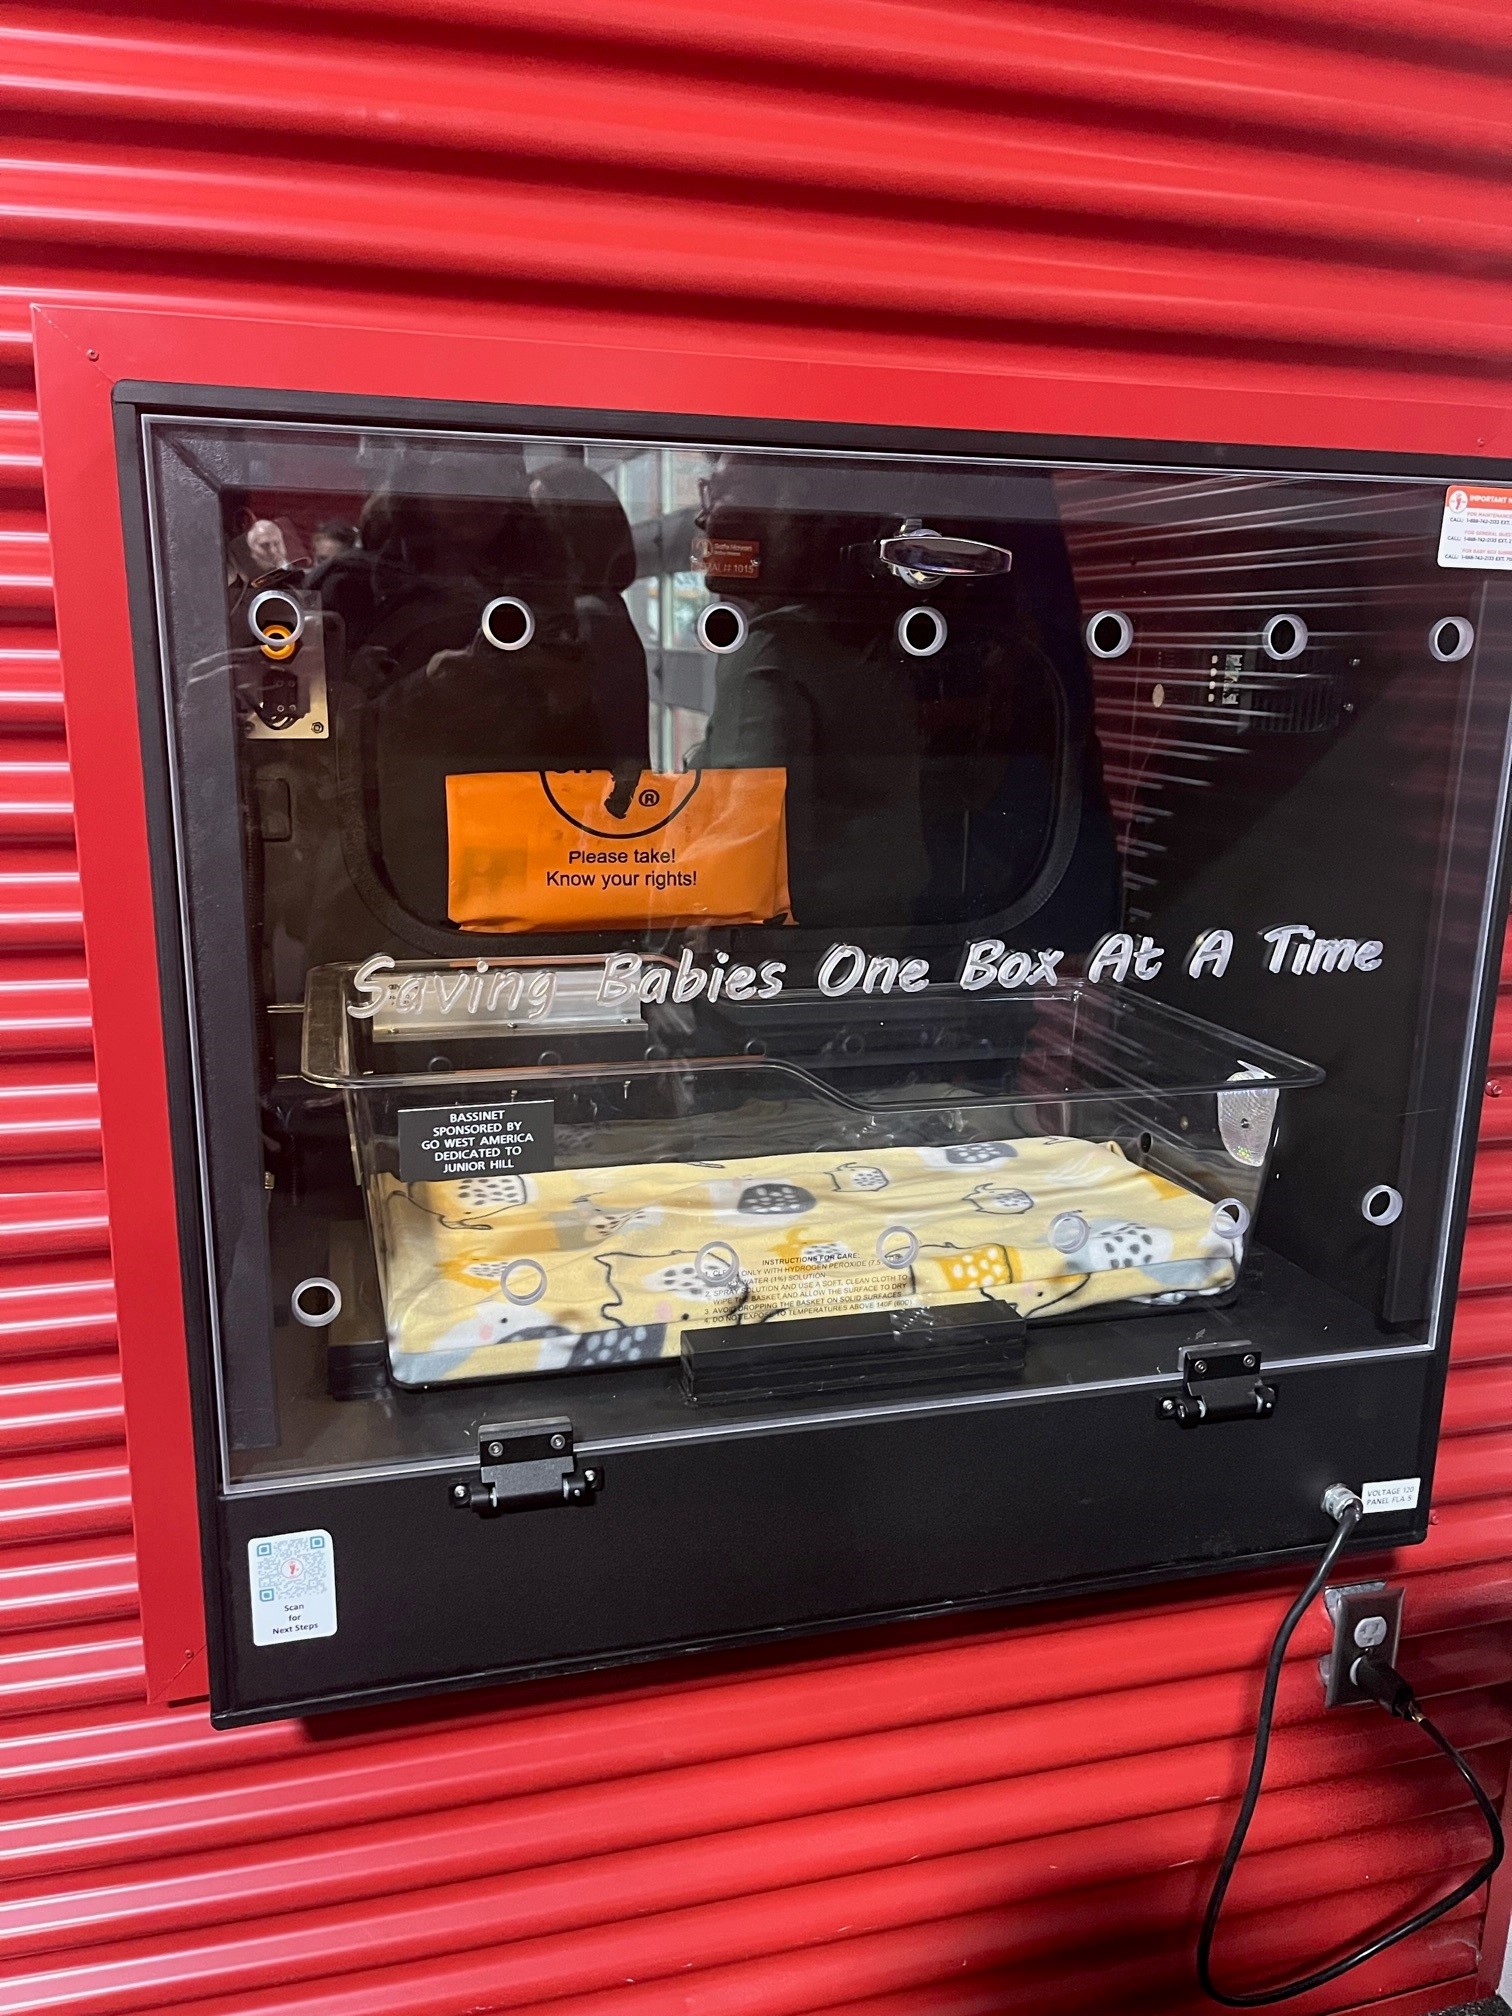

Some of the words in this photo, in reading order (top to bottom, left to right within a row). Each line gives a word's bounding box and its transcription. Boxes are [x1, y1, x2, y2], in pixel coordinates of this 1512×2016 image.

[1470, 494, 1508, 504] IMPORTANT
[568, 850, 628, 864] Please
[634, 848, 676, 863] take!
[546, 871, 596, 886] Know
[601, 874, 640, 890] your
[645, 870, 698, 889] rights!
[347, 954, 559, 1023] Saving
[597, 948, 788, 1007] Babies
[815, 941, 930, 997] One
[961, 938, 1065, 991] Box
[1086, 932, 1164, 984] At
[1188, 928, 1234, 979] A
[1261, 923, 1383, 976] Time
[450, 1110, 506, 1123] BASSINET
[432, 1124, 502, 1137] SPONSORED
[506, 1121, 522, 1130] BY
[421, 1140, 440, 1150] GO
[444, 1136, 476, 1148] WEST
[479, 1132, 534, 1146] AMERICA
[434, 1148, 500, 1162] DEDICATED
[505, 1146, 522, 1156] TO
[442, 1160, 486, 1174] JUNIOR
[490, 1158, 514, 1170] HILL
[741, 1268, 761, 1276] ONLY
[784, 1264, 827, 1272] HYDROGEN
[829, 1260, 866, 1269] PEROXIDE
[762, 1256, 818, 1266] INSTRUCTIONS
[788, 1272, 826, 1281] SOLUTION
[714, 1288, 739, 1296] SPRAY
[741, 1286, 778, 1295] SOLUTION
[800, 1289, 826, 1298] ALLOW
[844, 1285, 877, 1293] SURFACE
[738, 1303, 778, 1311] DROPPING
[796, 1298, 825, 1306] BASKET
[863, 1292, 902, 1300] SURFACES
[789, 1305, 848, 1315] TEMPERATURES
[850, 1302, 875, 1310] ABOVE
[1367, 1488, 1400, 1497] VOLTAGE
[295, 1622, 318, 1631] Steps
